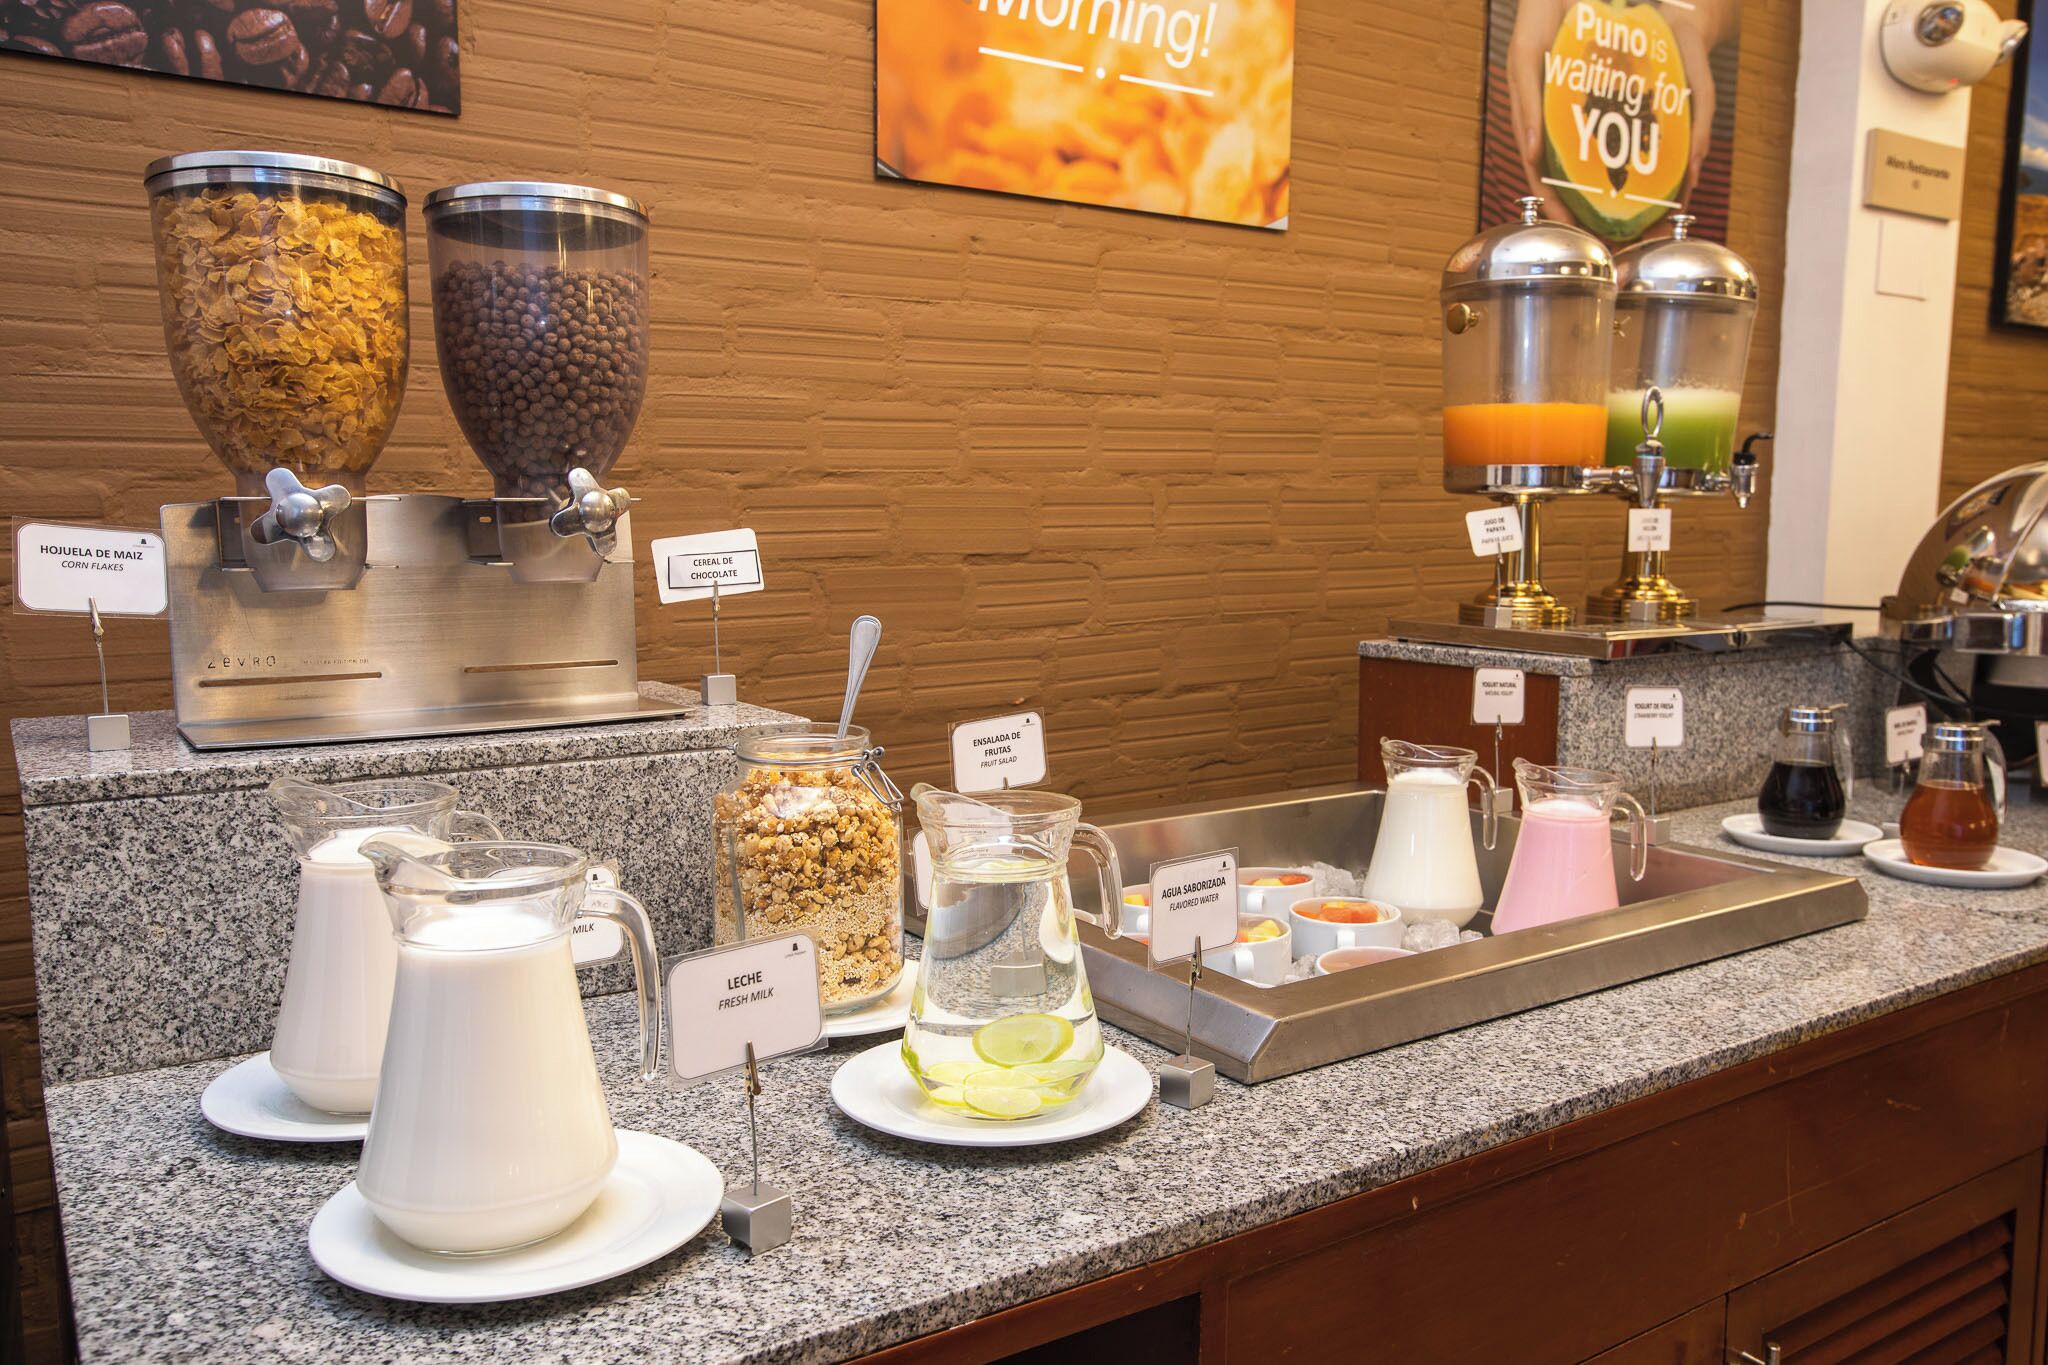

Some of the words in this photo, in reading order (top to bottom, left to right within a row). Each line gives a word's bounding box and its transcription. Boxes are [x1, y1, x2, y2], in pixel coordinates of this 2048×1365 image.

[1576, 2, 1648, 57] Puno
[1651, 30, 1668, 63] is
[1544, 51, 1646, 116] waiting
[1653, 71, 1691, 116] for
[1571, 104, 1660, 175] YOU
[40, 545, 92, 557] HOJUELA
[96, 549, 110, 559] DE
[114, 550, 143, 560] MAIZ
[61, 560, 88, 569] CORN
[91, 562, 124, 571] FLAKES
[693, 558, 720, 566] CEREAL
[722, 557, 734, 565] DE
[691, 570, 738, 580] CHOCOLATE
[973, 733, 1010, 747] ENSALADA
[1011, 731, 1021, 740] DE
[984, 745, 1012, 757] FRUTAS
[980, 760, 997, 768] FRUIT
[998, 755, 1017, 765] SALAD
[1161, 885, 1182, 900] AGUA
[1183, 876, 1226, 894] SABORIZADA
[1169, 898, 1198, 912] FLAVORED
[1199, 893, 1219, 905] WATER
[572, 923, 595, 934] MILK
[727, 971, 763, 990] LECHE
[718, 994, 748, 1011] FRESH
[750, 987, 774, 1002] MILK
